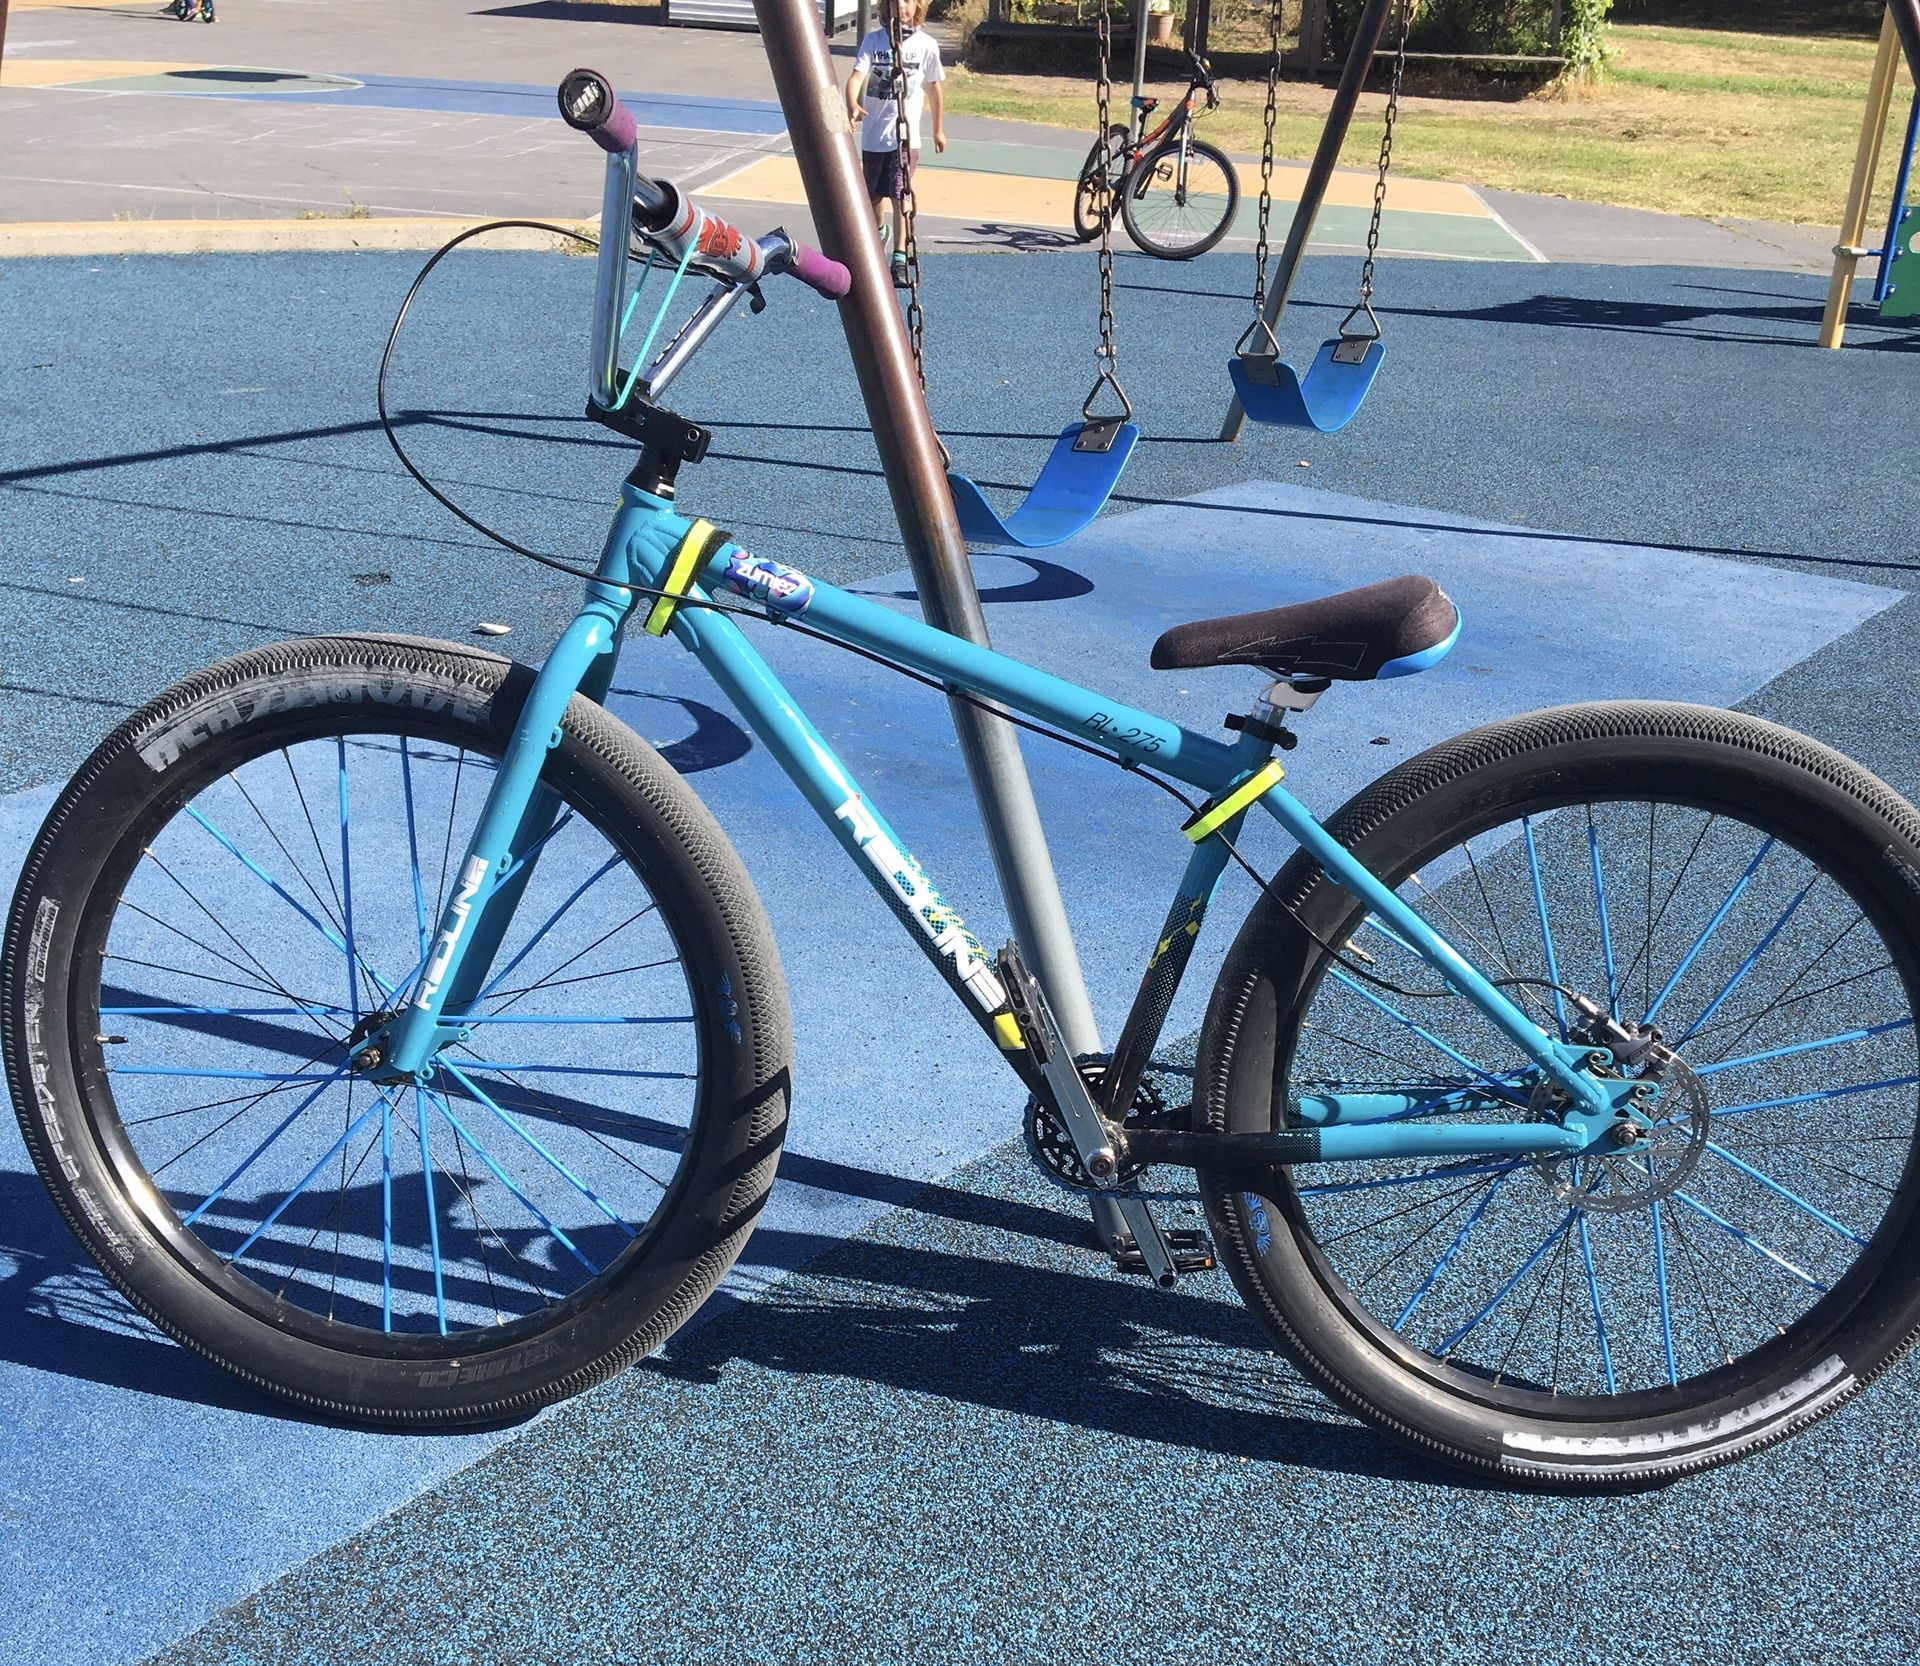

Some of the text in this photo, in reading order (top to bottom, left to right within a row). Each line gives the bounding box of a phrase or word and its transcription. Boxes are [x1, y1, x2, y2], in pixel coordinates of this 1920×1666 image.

[1117, 727, 1167, 753] 275
[413, 853, 489, 1011] REDLINE
[834, 799, 1007, 1014] REDLINE
